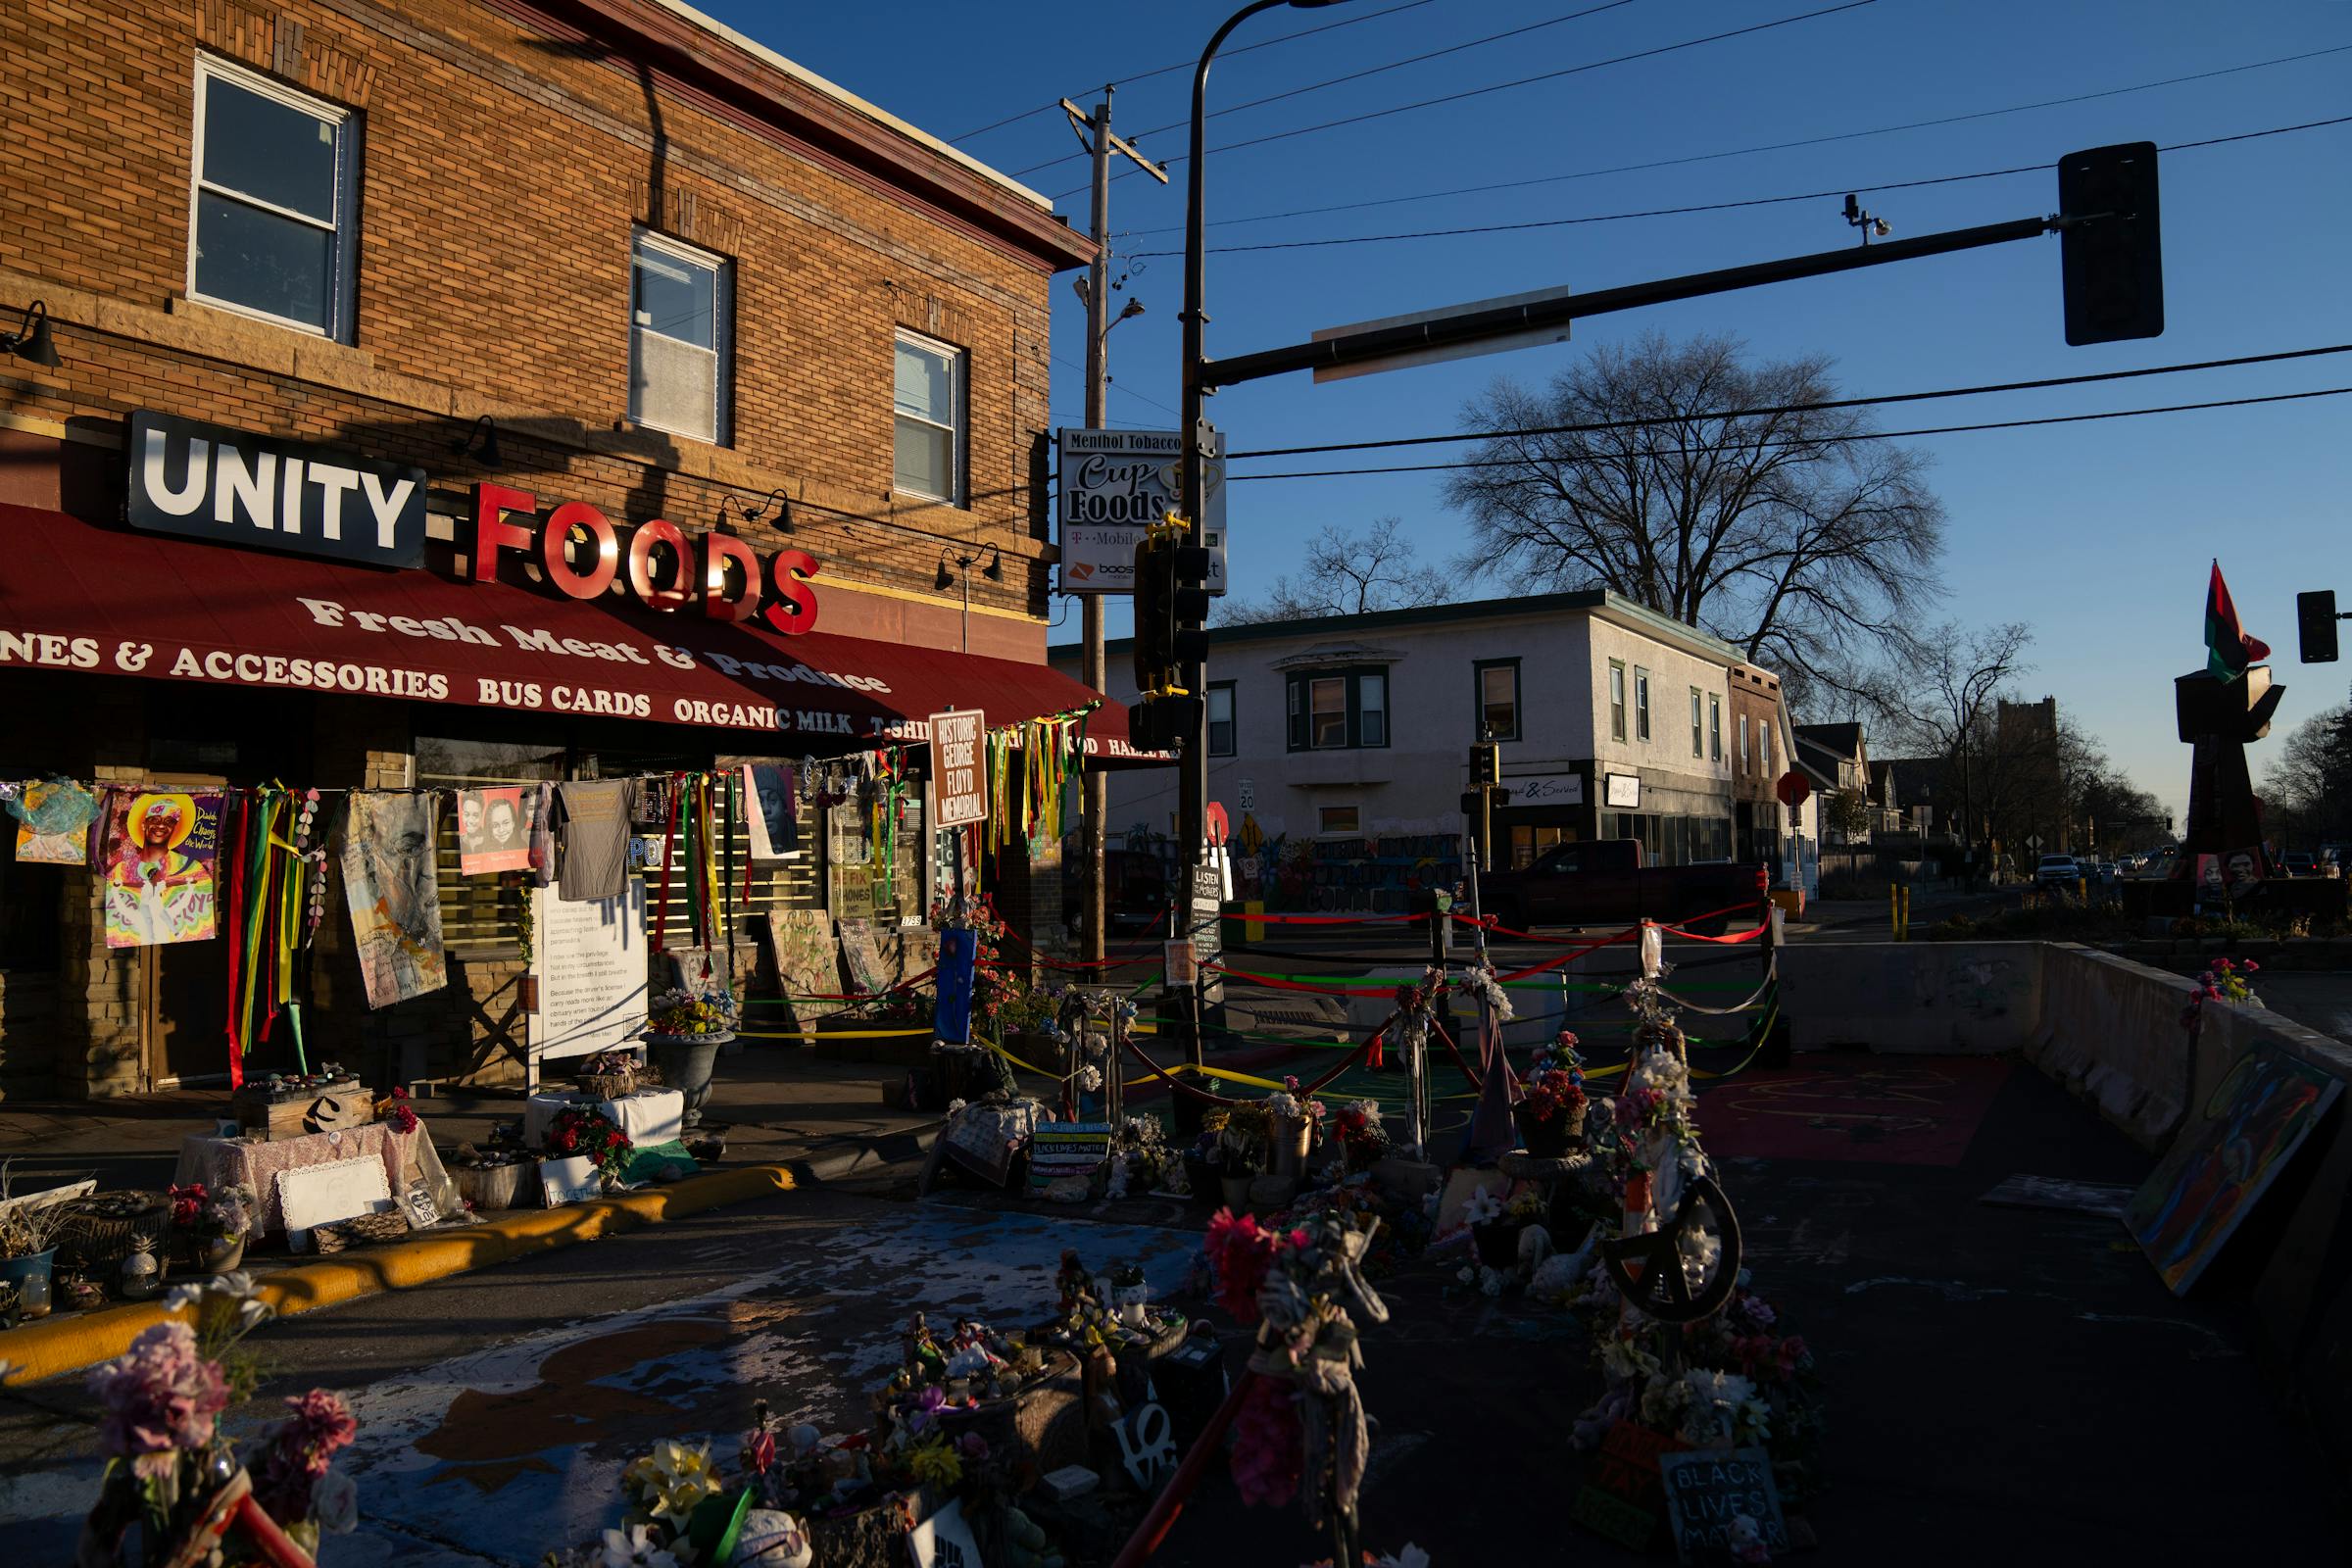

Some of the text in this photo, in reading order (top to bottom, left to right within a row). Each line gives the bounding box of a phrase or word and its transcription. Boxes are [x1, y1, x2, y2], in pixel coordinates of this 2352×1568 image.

[1071, 434, 1182, 450] Menthol Tobacco
[143, 428, 416, 549] UNITY
[1079, 456, 1158, 496] Cup
[1070, 490, 1164, 521] Foods
[474, 483, 820, 635] FOODS
[1100, 564, 1135, 573] boos
[296, 596, 892, 695] Fresh Meat & Produce
[0, 629, 101, 670] NES
[115, 640, 154, 671] &
[170, 647, 449, 700] ACCESSORIES
[477, 678, 543, 709] BUS
[551, 685, 651, 717] CARDS
[673, 698, 790, 731] ORGANIC
[796, 710, 854, 735] MILK
[870, 715, 929, 742] T-SHI
[938, 715, 977, 745] HISTORIC
[943, 741, 975, 768] GEORGE
[947, 768, 973, 796] FLOYD
[1526, 782, 1542, 798] &
[941, 793, 982, 822] MEMORIAL
[1241, 796, 1253, 808] 20
[850, 871, 866, 885] FIX
[1196, 870, 1218, 884] LISTEN
[903, 916, 921, 926] 3759
[1675, 1461, 1763, 1489] BLACK
[1683, 1491, 1766, 1520] LIVES
[1683, 1521, 1787, 1553] MATR
